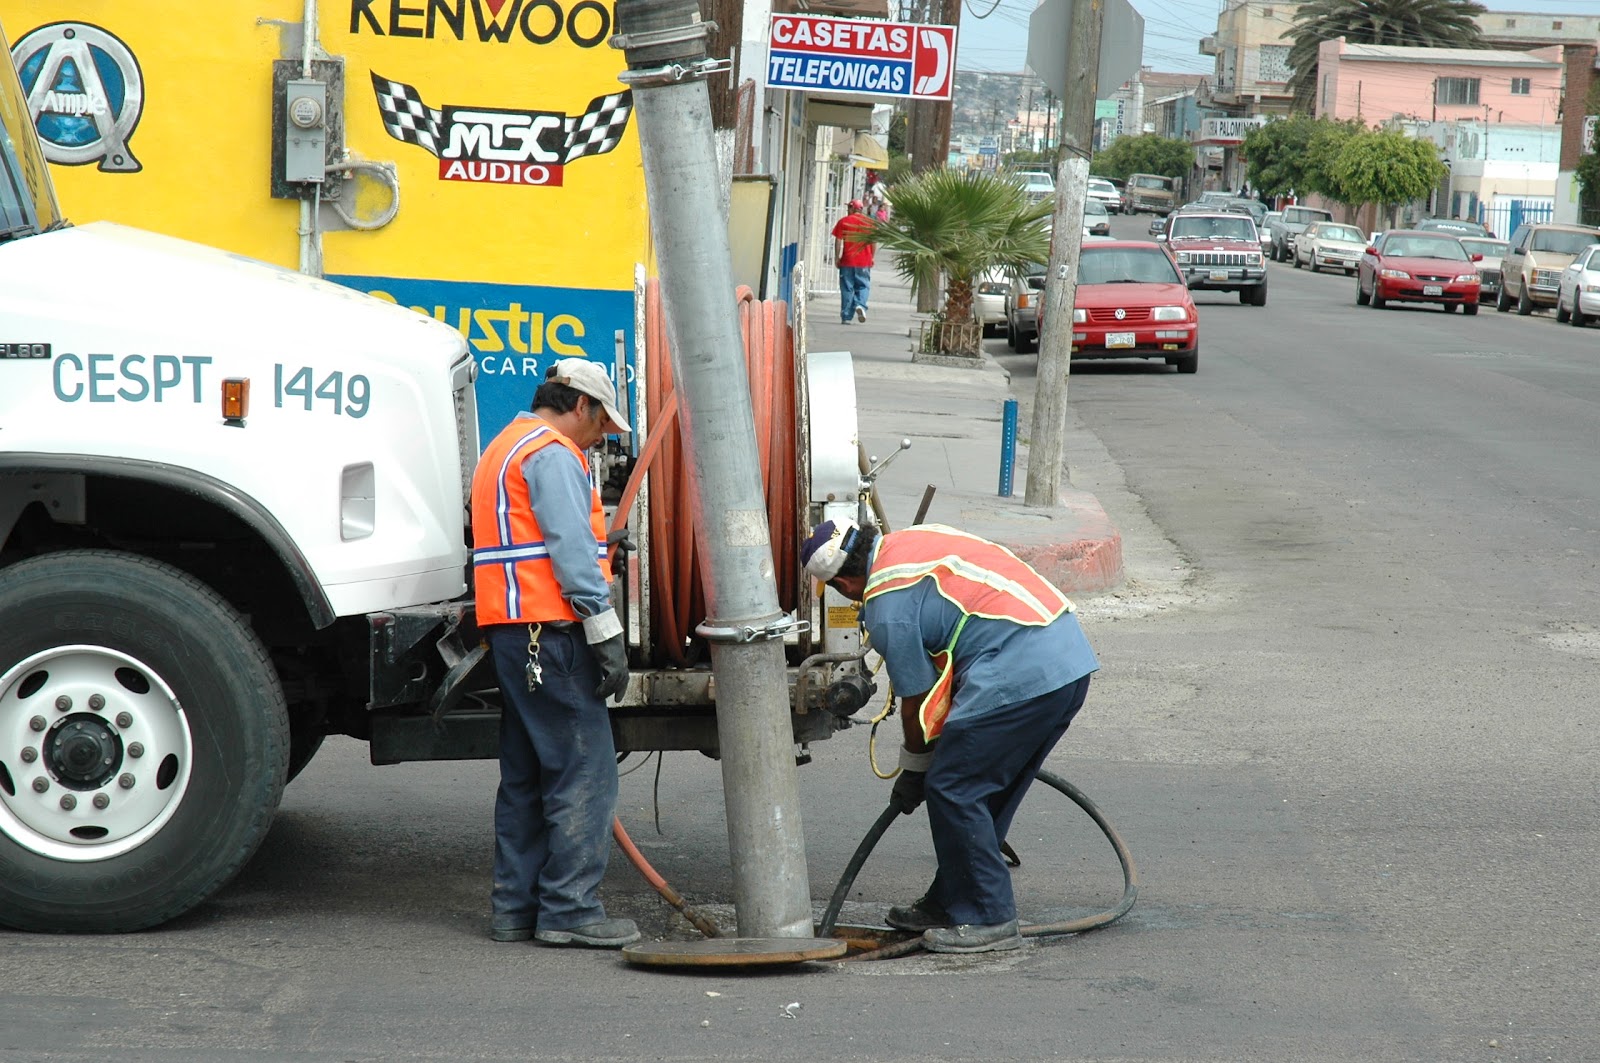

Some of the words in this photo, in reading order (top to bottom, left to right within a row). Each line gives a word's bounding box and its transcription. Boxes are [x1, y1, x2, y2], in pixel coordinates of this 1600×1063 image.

[350, 0, 620, 48] KENWOO
[773, 19, 908, 53] CASETAS
[770, 56, 906, 91] TELEFONICAS
[1116, 99, 1125, 135] MERCADO
[441, 110, 561, 163] MTX
[445, 160, 550, 184] AUDIO
[481, 356, 538, 377] CAR
[52, 353, 212, 403] CESPT
[274, 363, 371, 419] 1449
